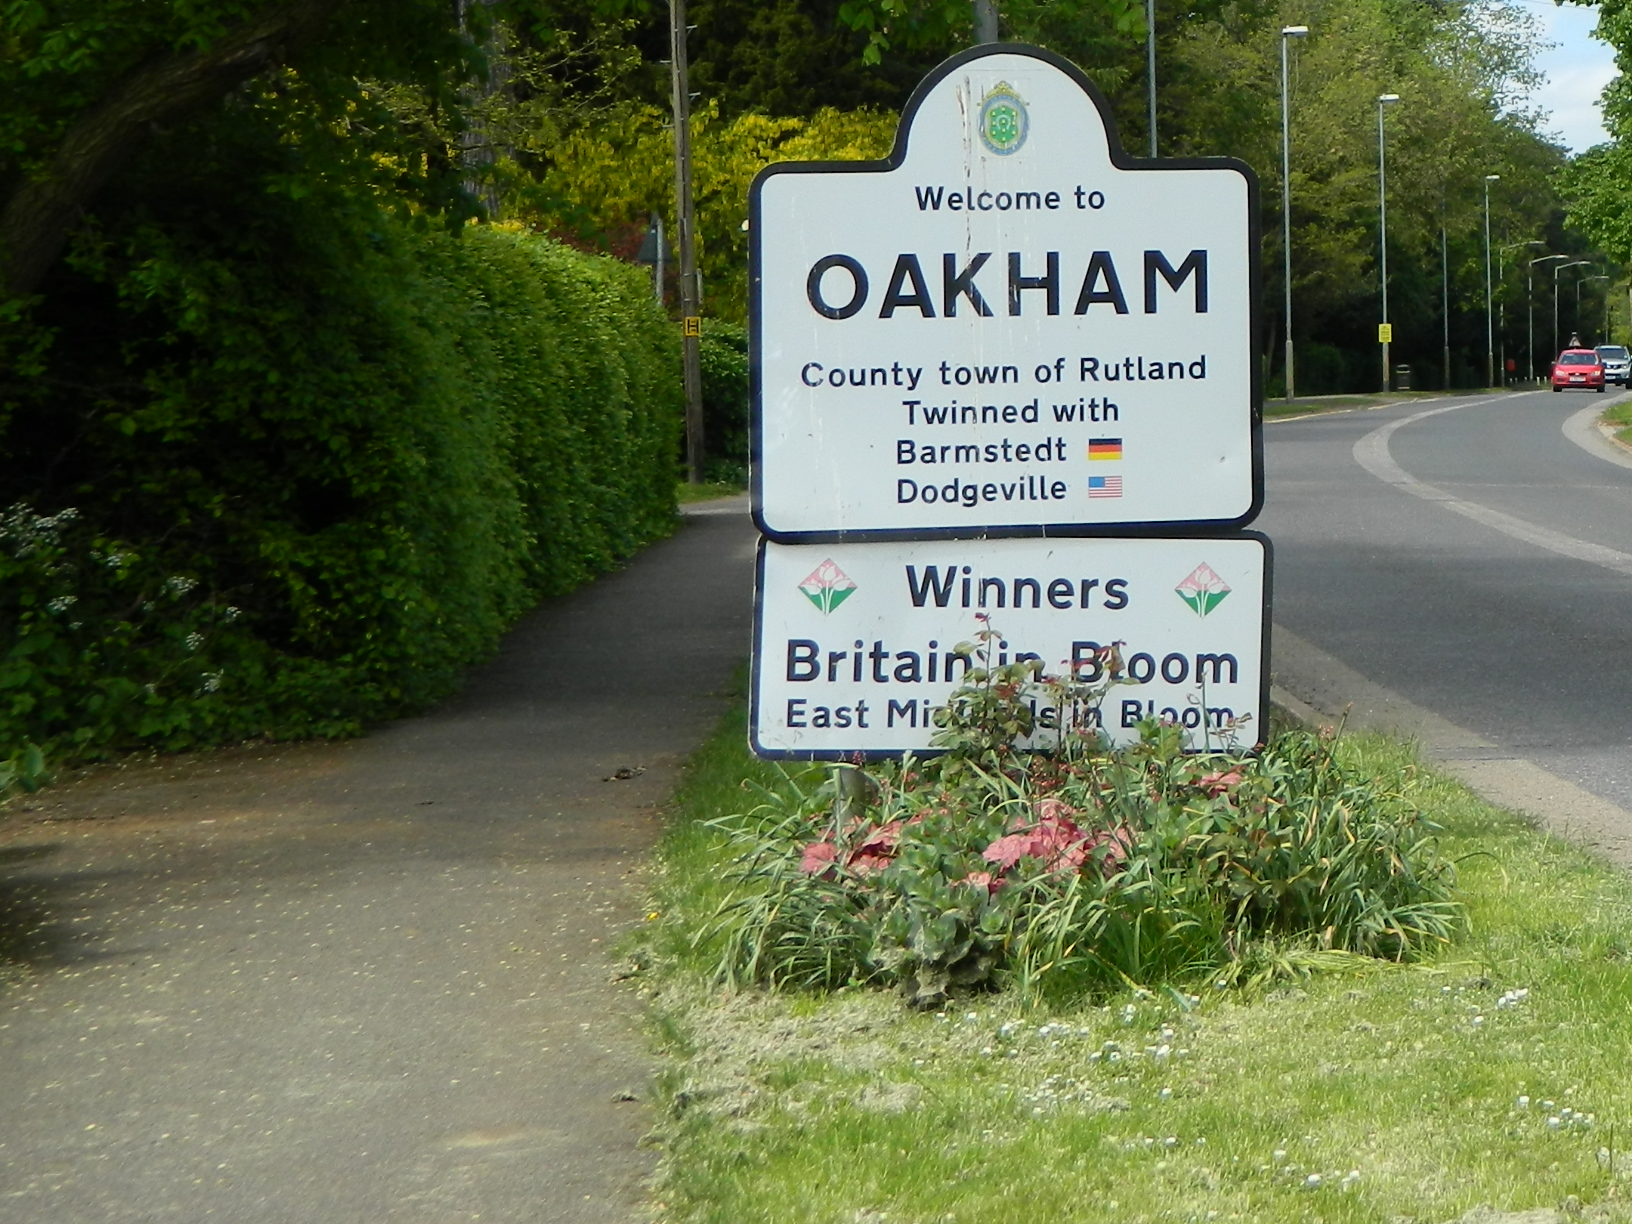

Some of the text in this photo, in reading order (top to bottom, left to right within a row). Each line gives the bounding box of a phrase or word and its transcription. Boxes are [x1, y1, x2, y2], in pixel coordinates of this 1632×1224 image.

[915, 185, 1105, 211] Welcome to
[806, 249, 1208, 320] OAKHAM
[801, 354, 1206, 390] County town of Rutland
[902, 397, 1119, 426] Twinned with
[897, 436, 1067, 465] Barmstedt
[897, 475, 1067, 506] Dodgeville
[905, 565, 1129, 610] Winners
[786, 638, 973, 683] Britain
[998, 640, 1042, 683] in
[786, 698, 869, 728] East
